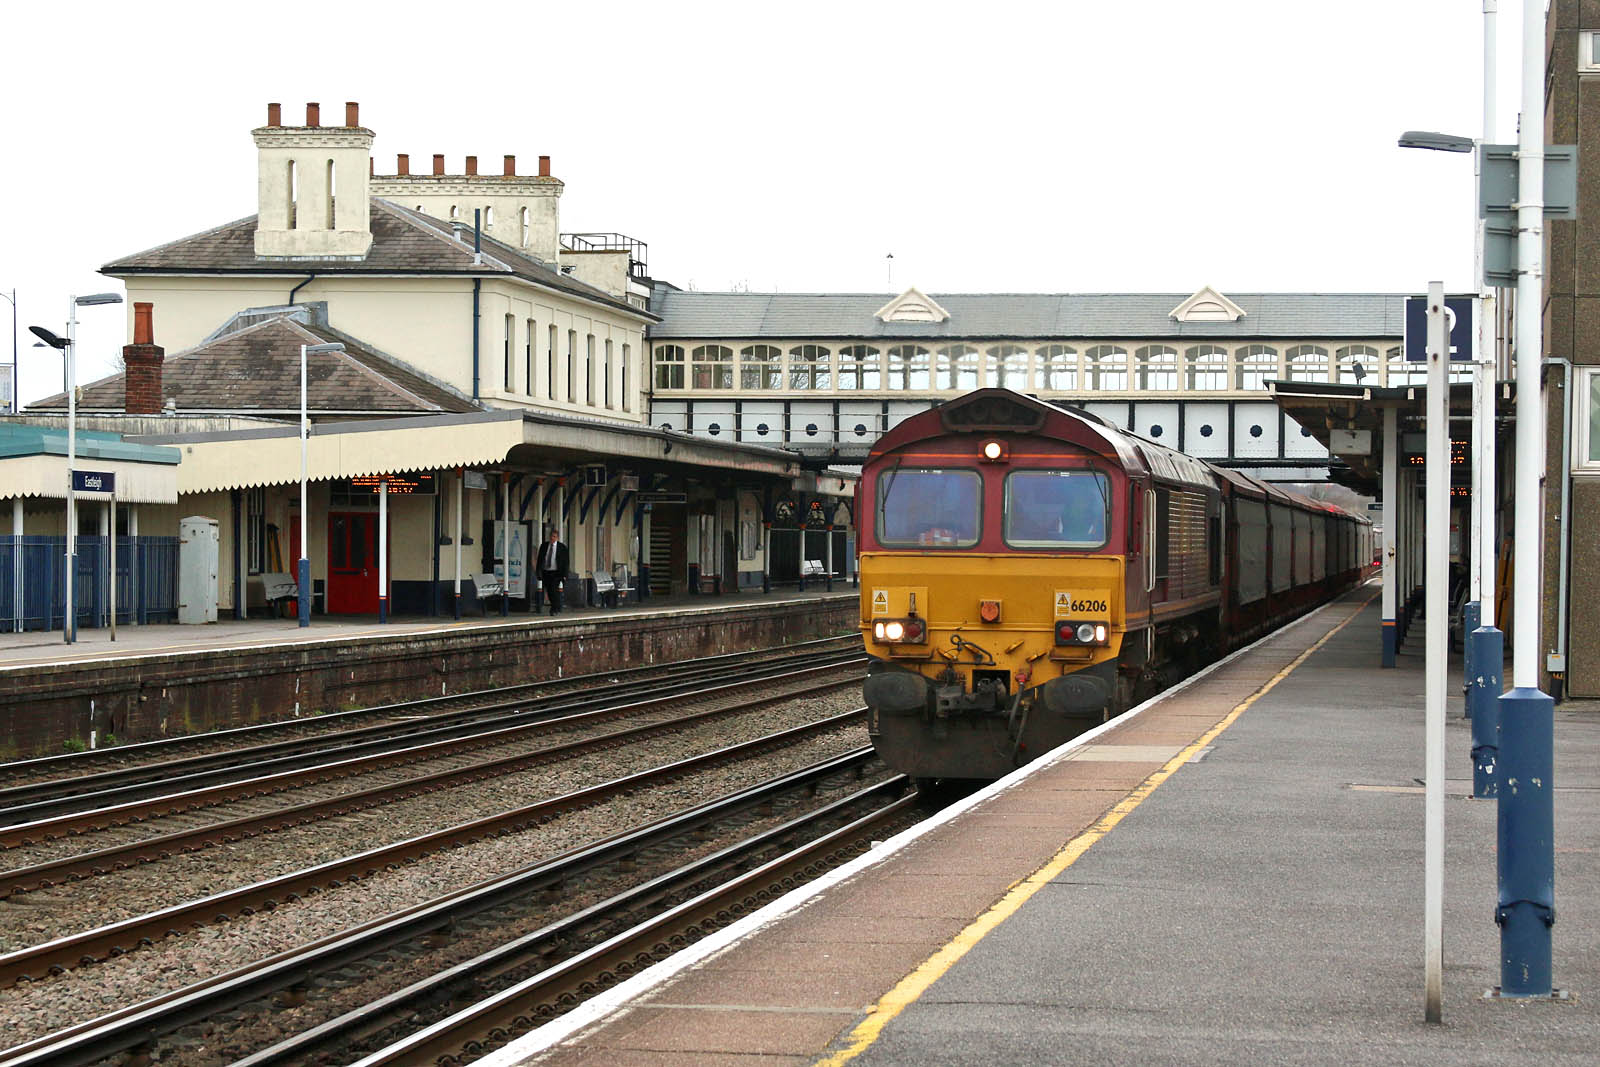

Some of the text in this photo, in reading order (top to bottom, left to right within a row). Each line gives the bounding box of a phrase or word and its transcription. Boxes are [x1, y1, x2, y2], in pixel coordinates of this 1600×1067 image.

[85, 475, 102, 490] Eastleigh
[593, 469, 599, 483] 1
[1071, 600, 1107, 612] 66206
